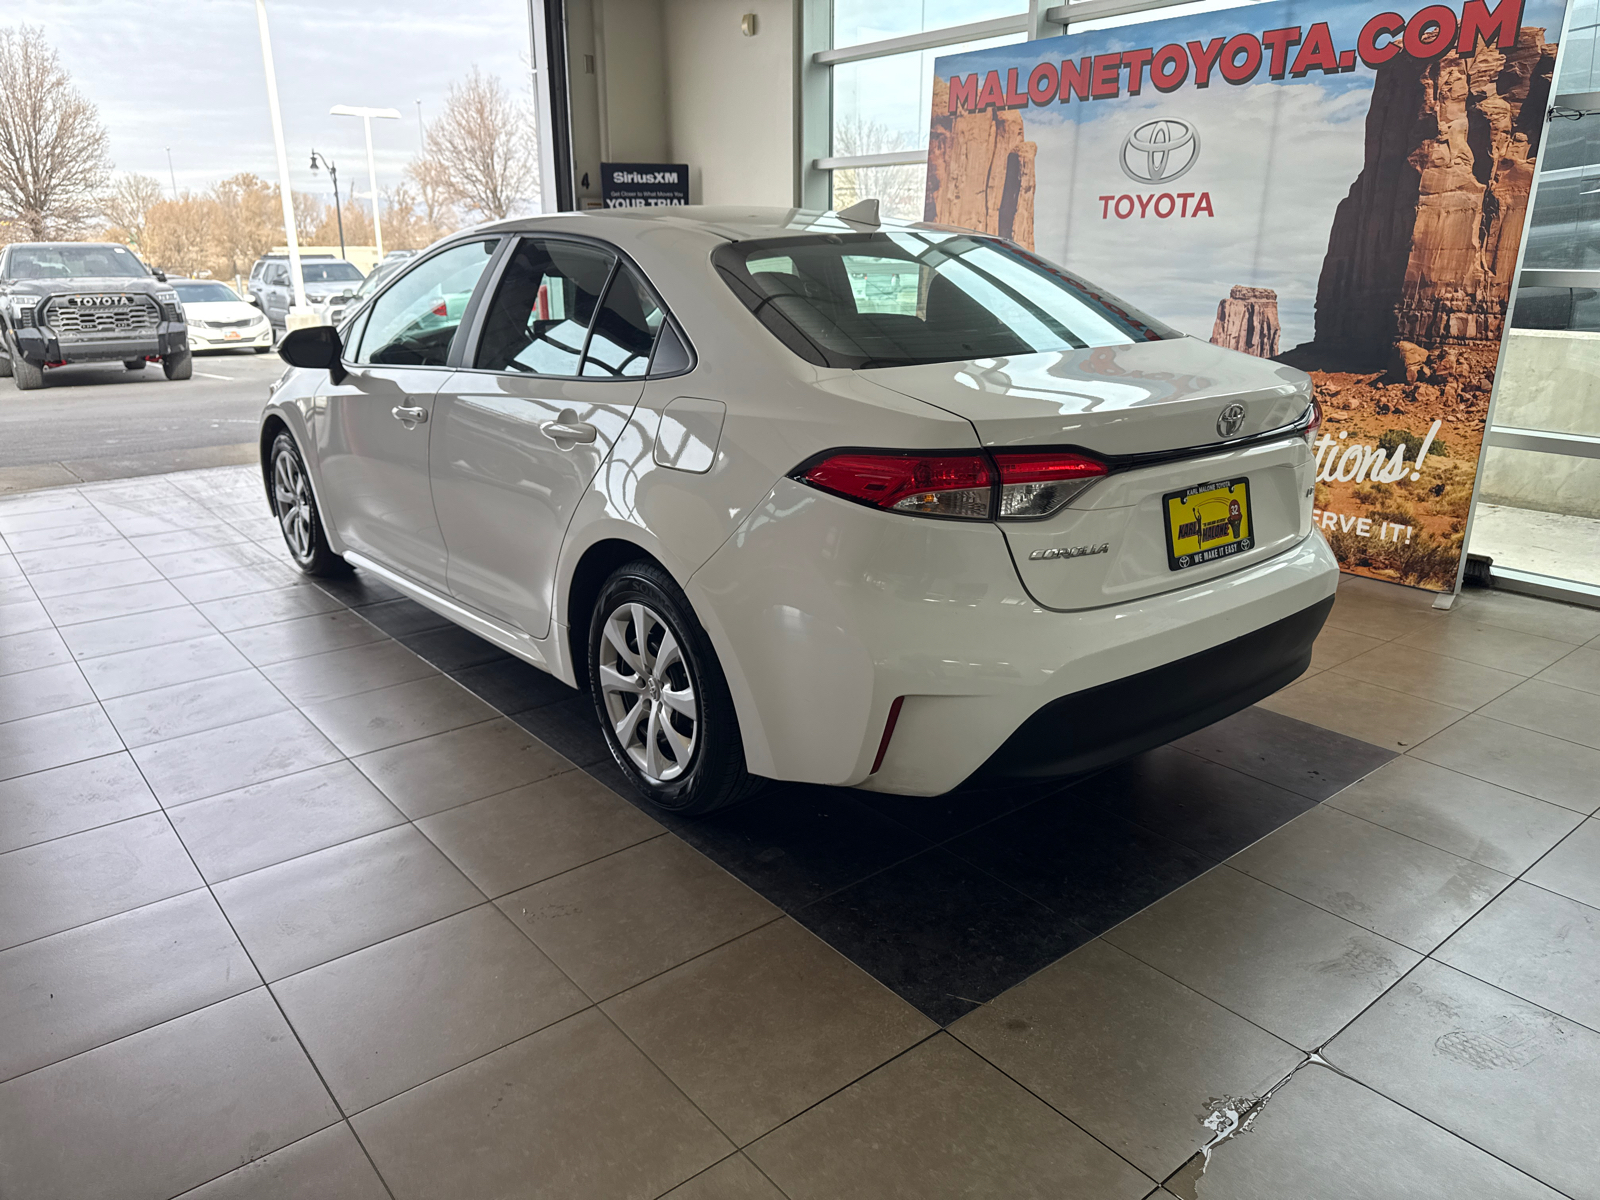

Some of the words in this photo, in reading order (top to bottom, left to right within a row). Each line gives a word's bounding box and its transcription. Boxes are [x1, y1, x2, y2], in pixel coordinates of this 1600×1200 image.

[948, 0, 1523, 113] MALONETOYOTA.COM
[613, 171, 678, 184] SiriusXM
[606, 198, 646, 209] YOUR
[1099, 192, 1215, 221] TOYOTA
[74, 296, 129, 307] TOYOTA
[1199, 483, 1216, 494] MALONE
[1216, 481, 1231, 490] TOYOTA
[1231, 504, 1239, 515] 32
[1178, 520, 1198, 540] KARL
[1202, 521, 1230, 543] MALONE
[1380, 521, 1413, 545] IT!
[1028, 542, 1110, 561] COROLLA
[1194, 553, 1203, 563] WE
[1203, 549, 1218, 561] MAKE
[1219, 546, 1225, 556] IT
[1225, 543, 1237, 554] EASY
